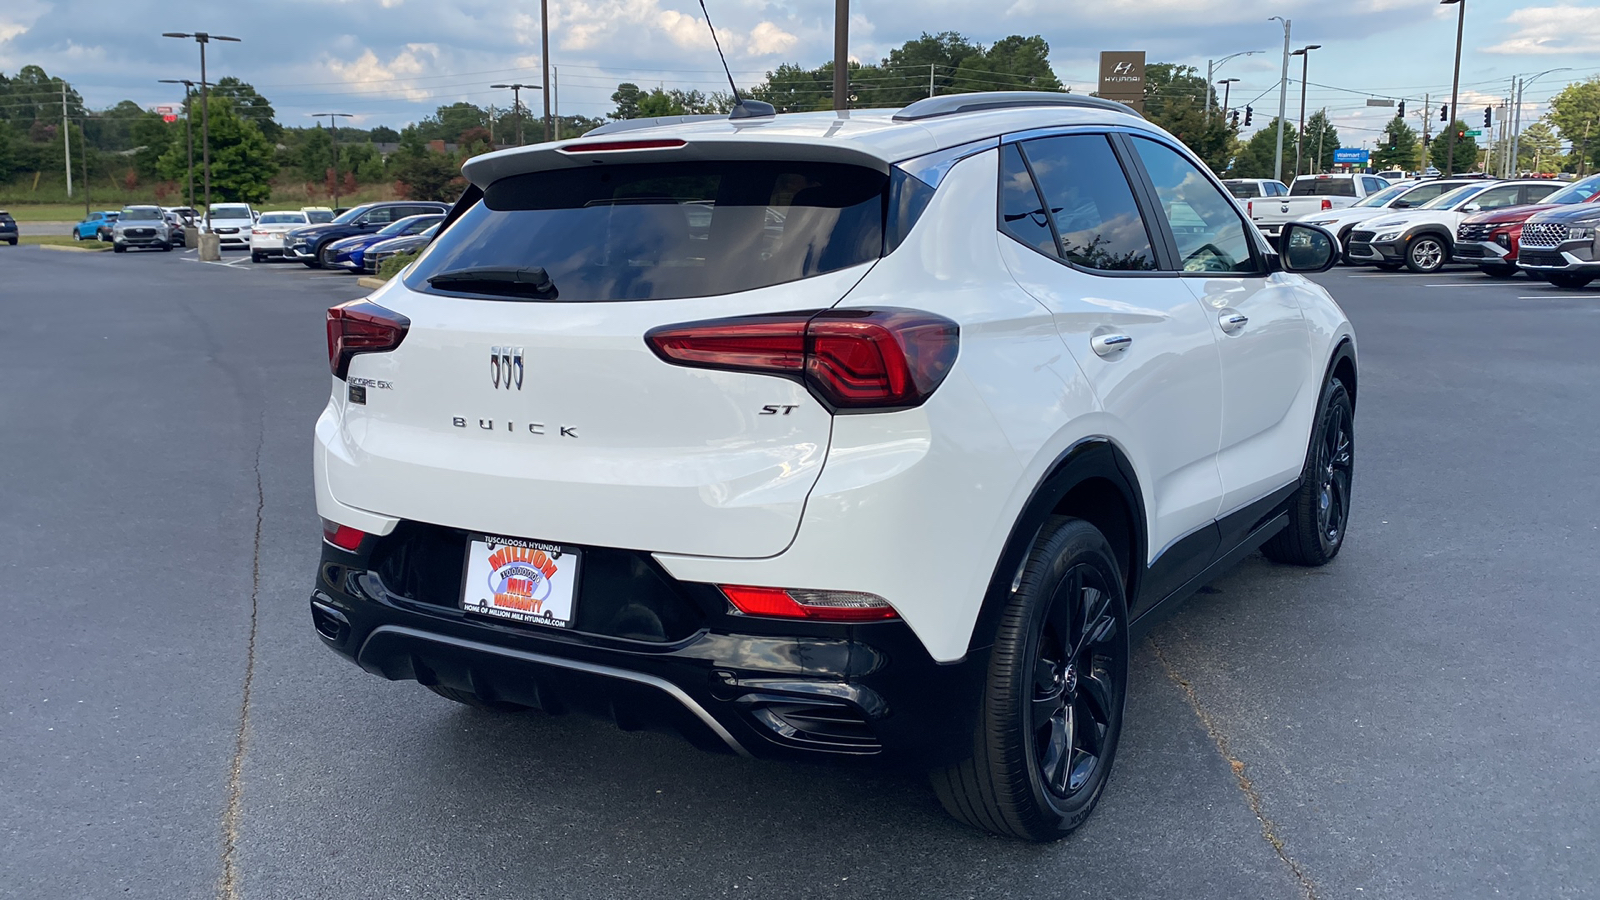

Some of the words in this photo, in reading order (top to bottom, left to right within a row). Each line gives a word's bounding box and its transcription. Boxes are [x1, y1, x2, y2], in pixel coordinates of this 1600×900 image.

[758, 404, 800, 415] ST
[452, 415, 579, 438] BUICK
[485, 536, 527, 547] TUSCALOOSA
[529, 542, 561, 552] HYUNDAI
[488, 546, 558, 580] MILLION
[507, 578, 533, 597] MILE
[494, 592, 544, 613] WARRANTY
[464, 604, 480, 613] HOME
[489, 609, 511, 619] MILLION
[511, 613, 524, 621] MILE
